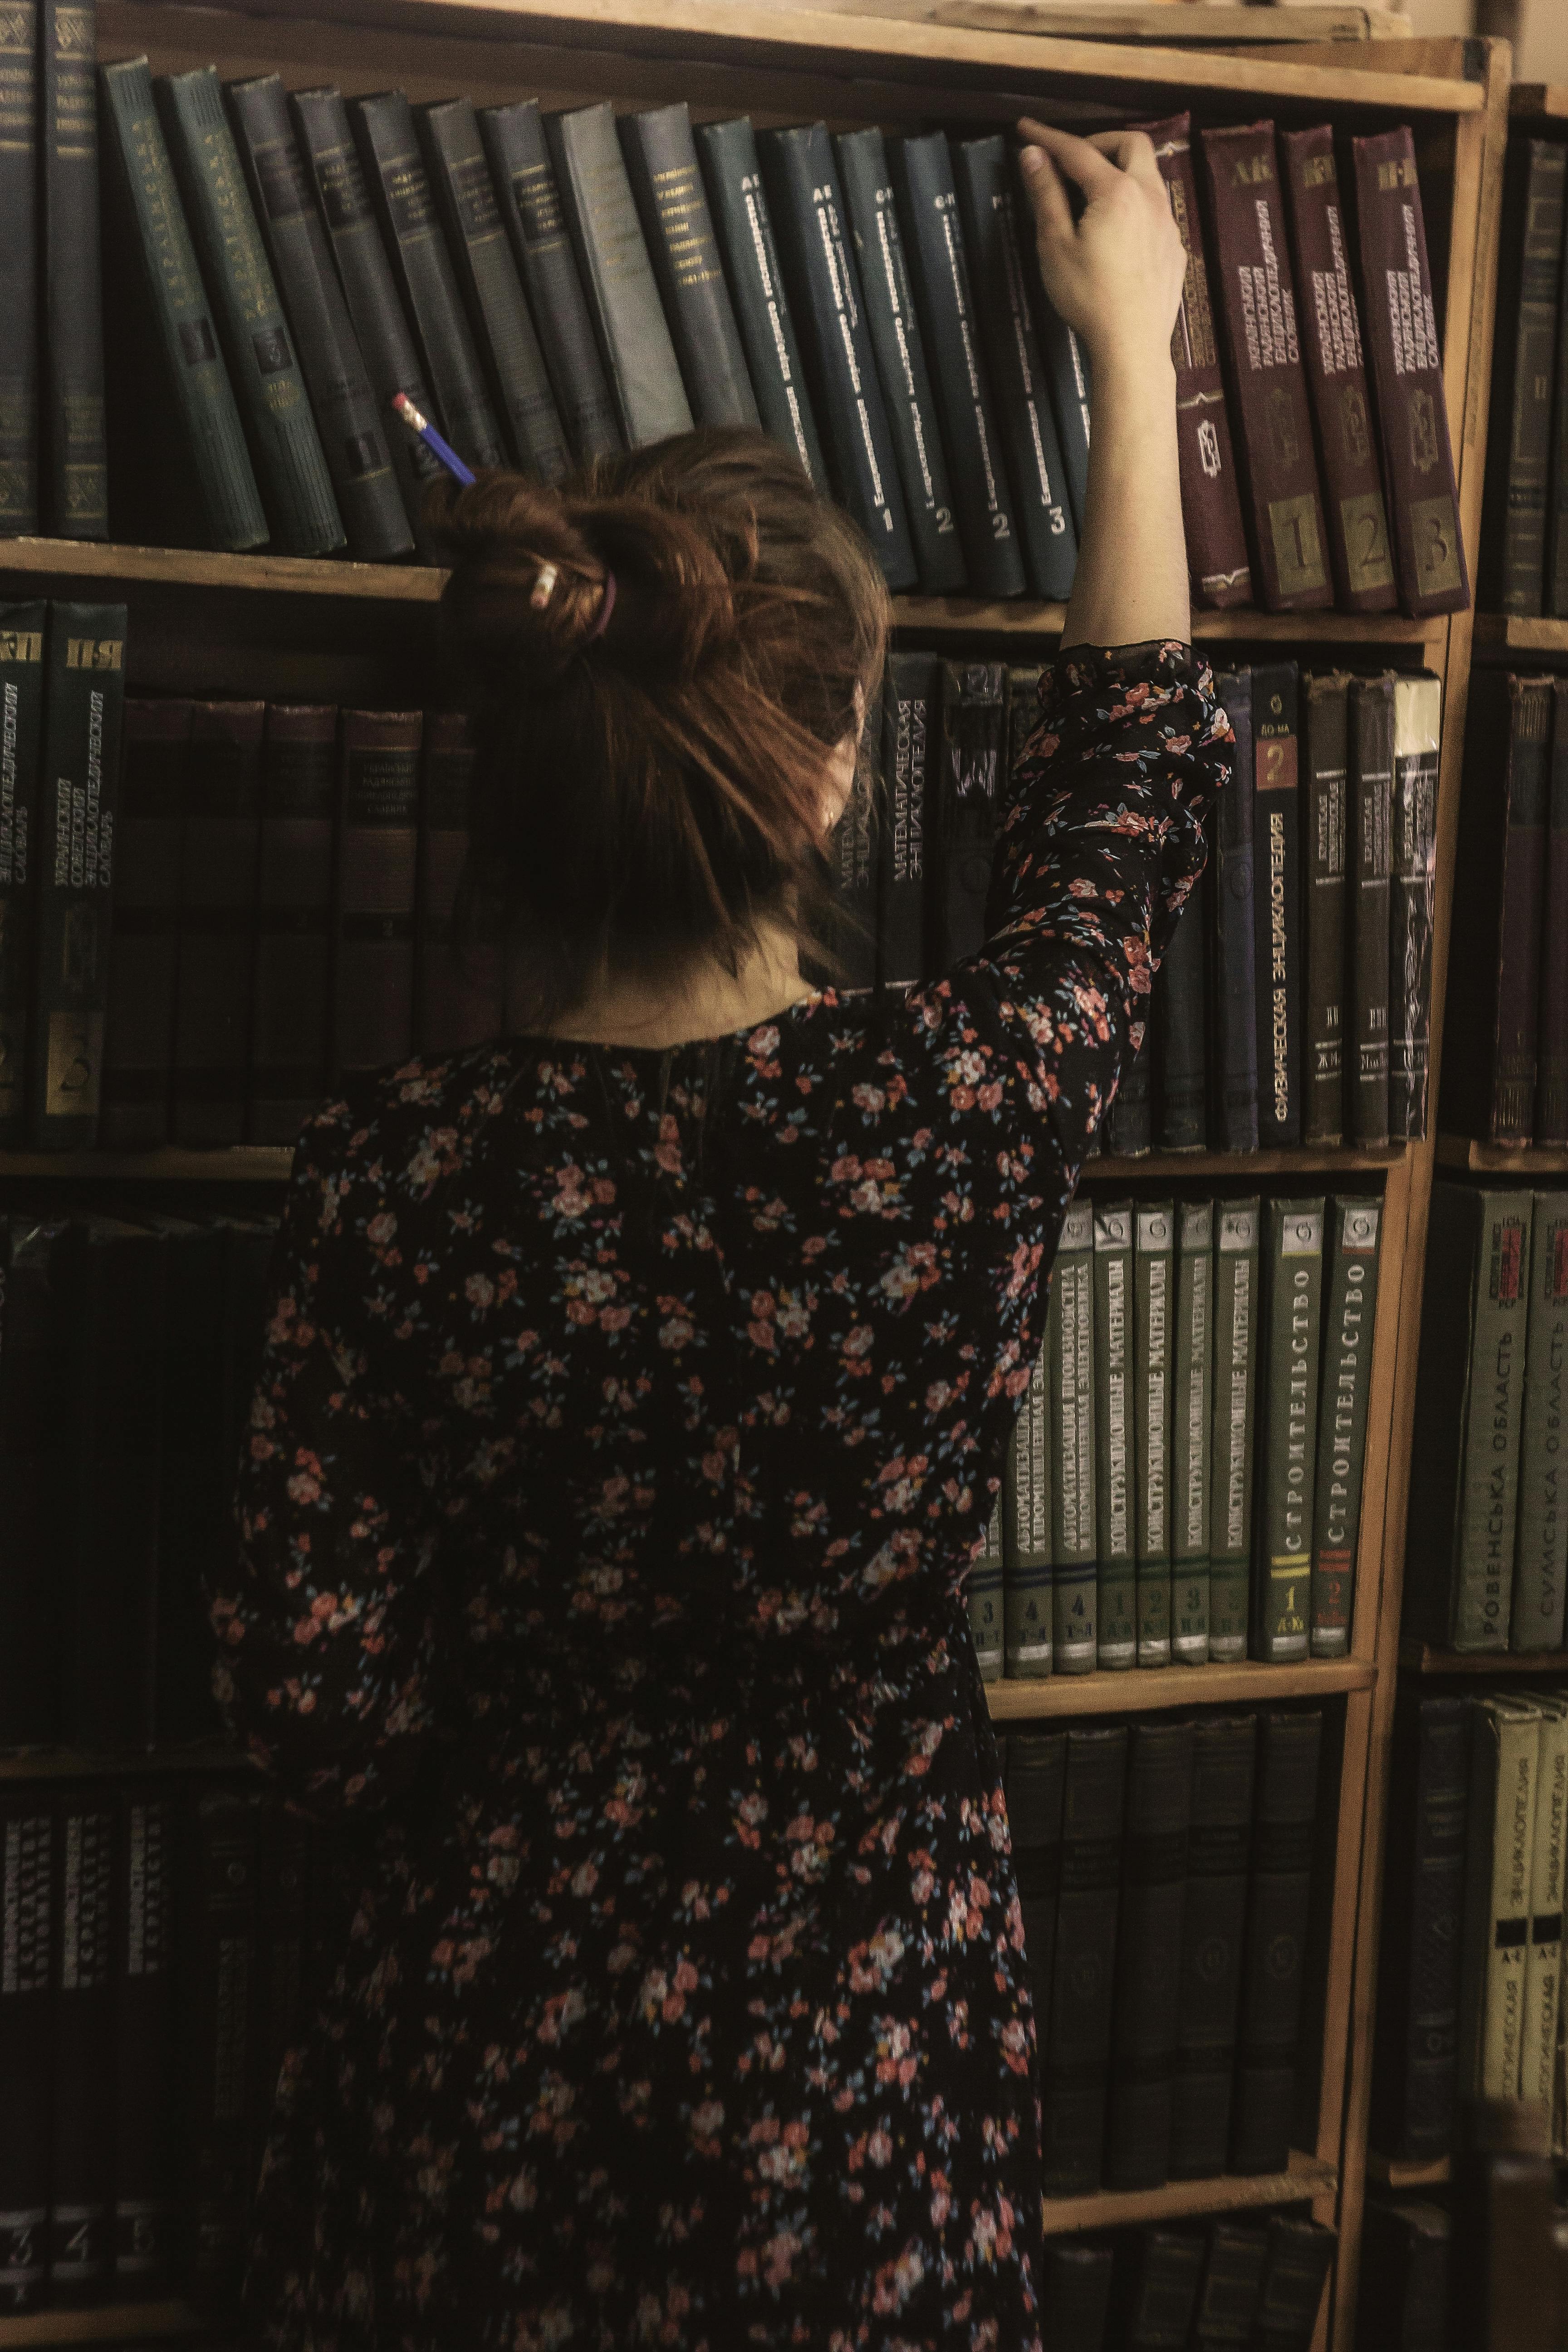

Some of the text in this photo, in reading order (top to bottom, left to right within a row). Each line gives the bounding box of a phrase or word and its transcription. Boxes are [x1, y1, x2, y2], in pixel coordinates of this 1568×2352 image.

[883, 508, 894, 532] 1
[936, 506, 954, 534] 2
[992, 512, 1010, 539] 2
[1049, 506, 1065, 535] 3
[1282, 512, 1306, 570] 1
[1358, 514, 1386, 566] 2
[1425, 518, 1449, 572] 3
[894, 700, 911, 881] МАТЕМАТИЧЕСКАЯ
[909, 699, 927, 880] ЭНЦИКЛОПЕДИЯ
[1267, 744, 1284, 783] 2
[1270, 812, 1288, 1122] ФИЗИЧЕСКАЯ ЭНЦИКЛОПЕДИЯ
[1108, 1259, 1127, 1555] КОНСТРУКЦИОННЫЕ МАТЕРИАЛЫ
[1147, 1259, 1166, 1552] КОНСТРУКЦИОННЫЕ МАТЕРИАЛЫ
[1188, 1257, 1207, 1548] КОНСТРУКЦИОННЫЕ МАТЕРИАЛЫ
[1228, 1259, 1250, 1548] КОНСТРУКЦИОННЫЕ МАТЕРИАЛЫ
[1285, 1270, 1309, 1551] СТРОИТЕЛЬСТВО
[1321, 1264, 1365, 1544] СТРОИТЕЛЬСТВО
[1546, 1320, 1565, 1453] ОБЛАСТЬ
[1483, 1331, 1512, 1635] РОВЕНСЬКА ОБЛАСТЬ
[1541, 1465, 1559, 1617] СУМСЬКА
[984, 1600, 994, 1624] 3
[1025, 1600, 1038, 1621] 4
[1072, 1594, 1084, 1616] 4
[1285, 1586, 1295, 1612] 1
[1328, 1581, 1341, 1605] 2
